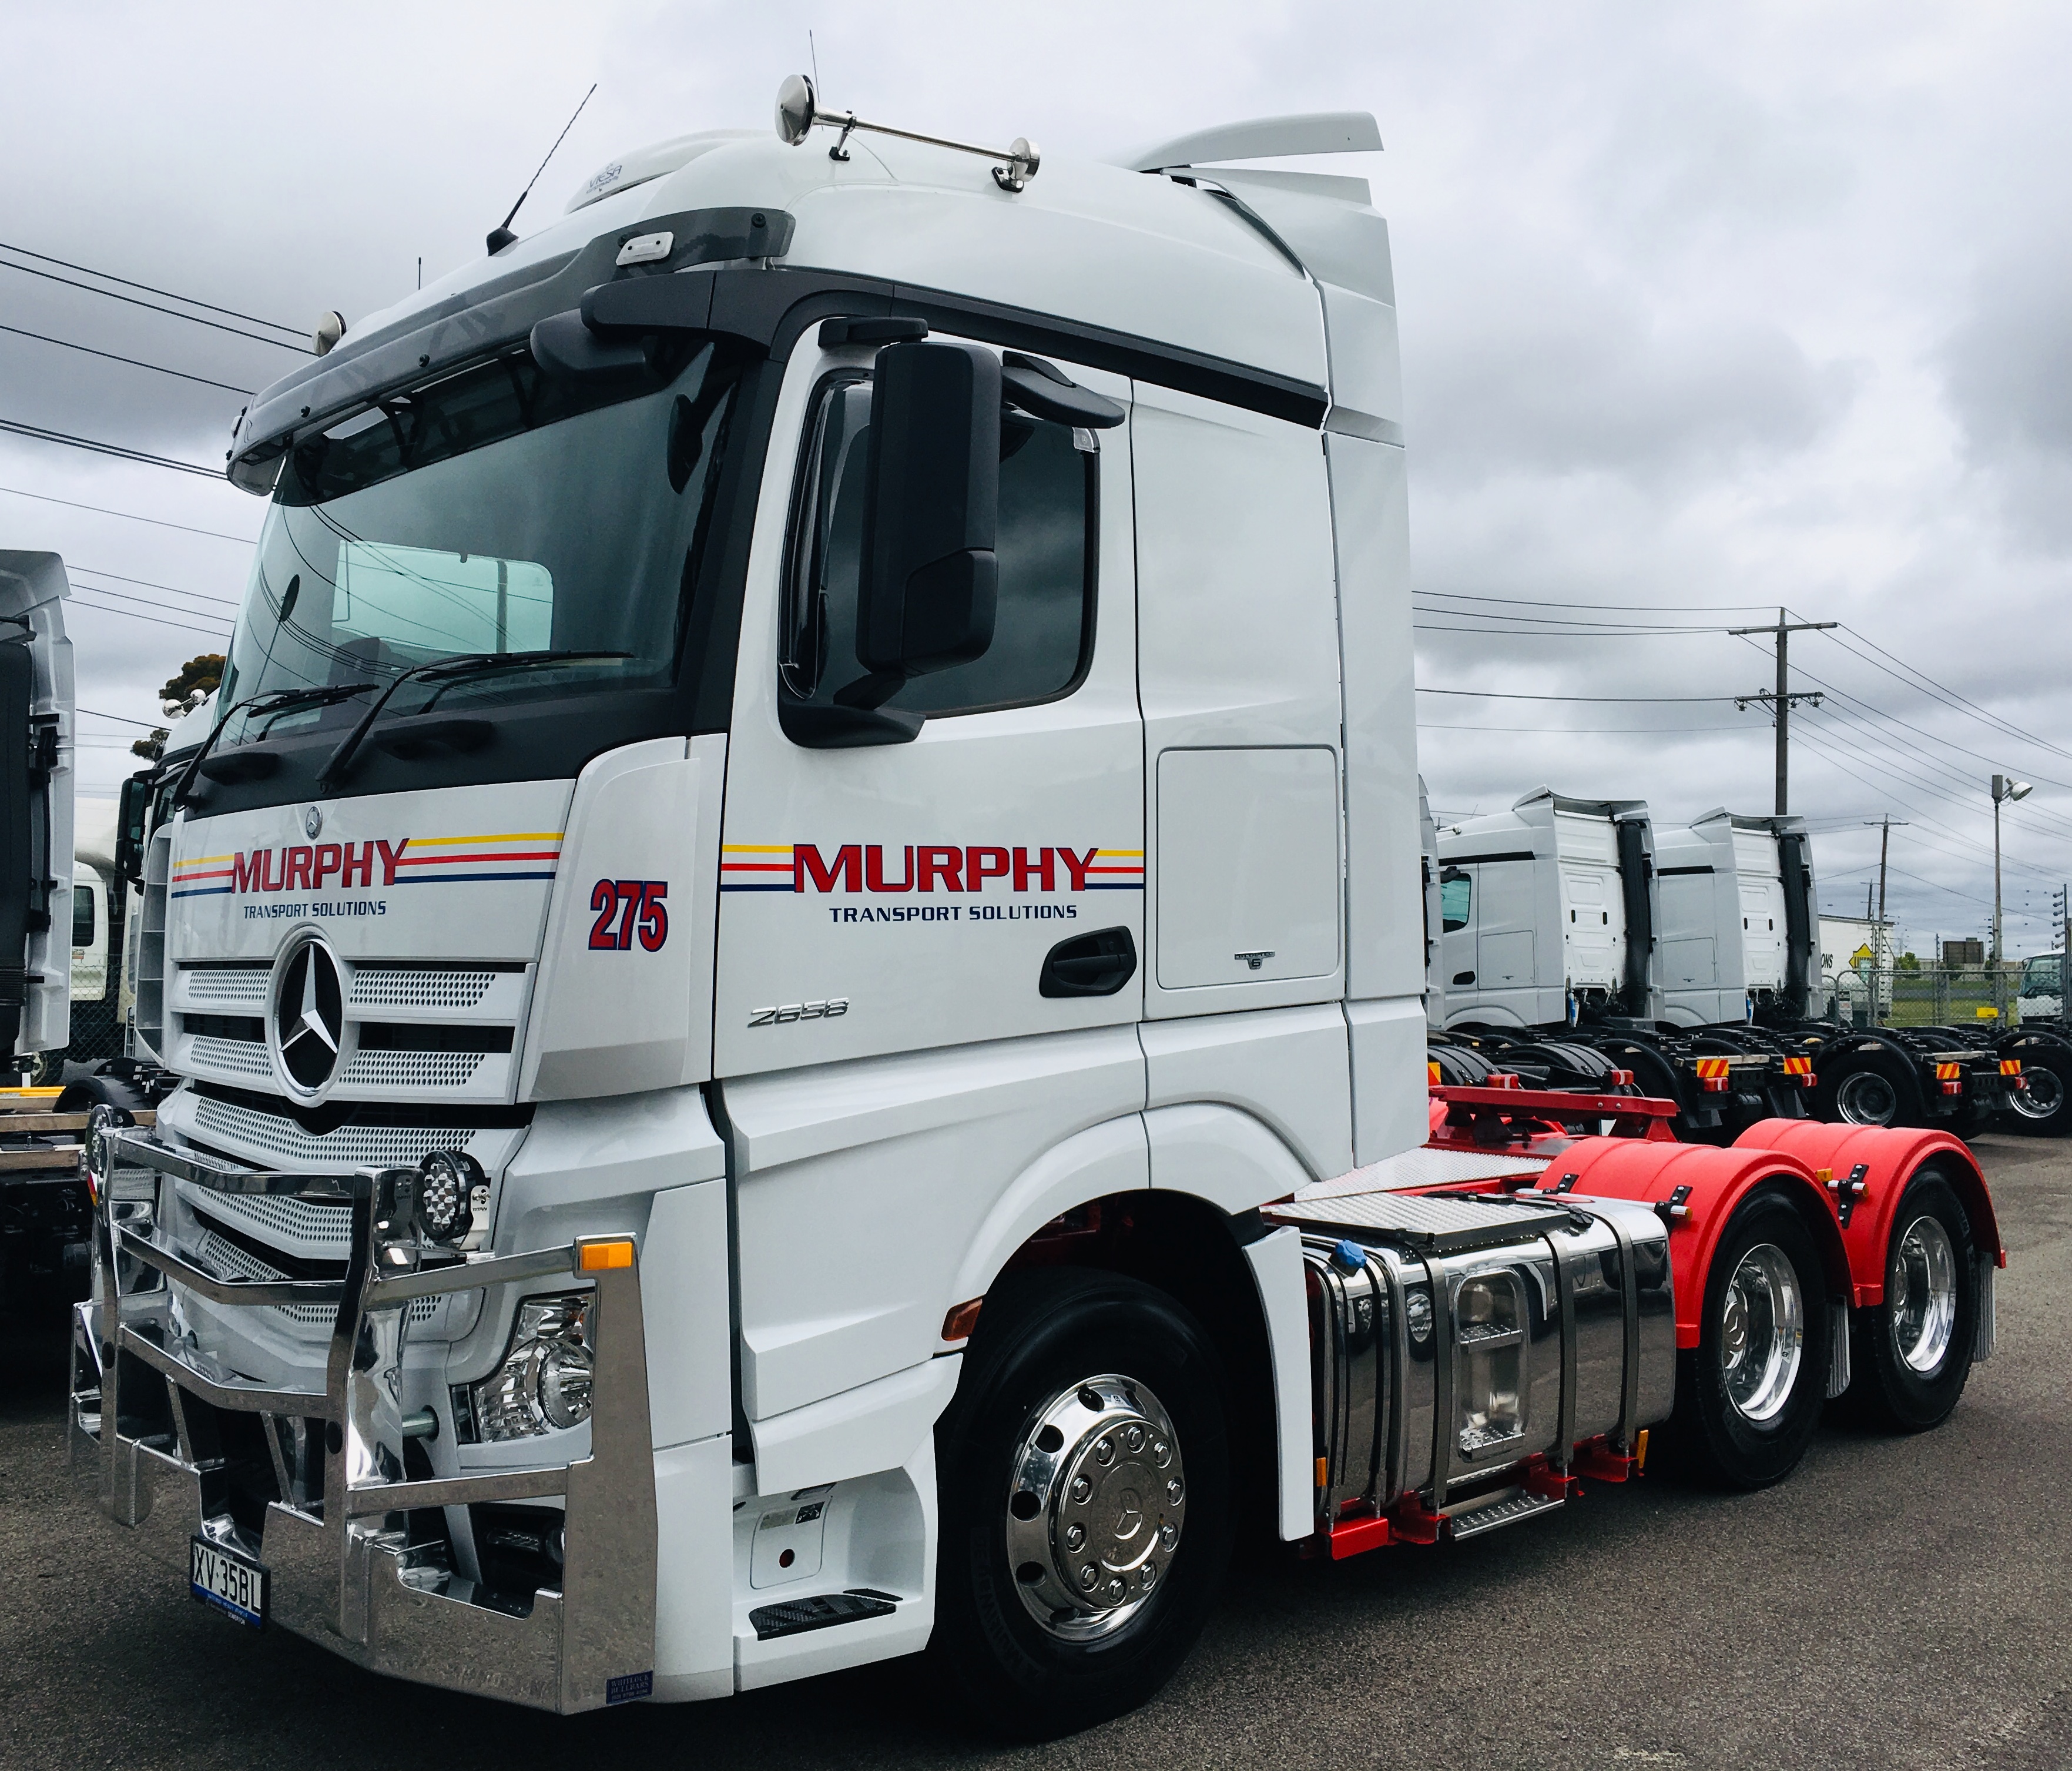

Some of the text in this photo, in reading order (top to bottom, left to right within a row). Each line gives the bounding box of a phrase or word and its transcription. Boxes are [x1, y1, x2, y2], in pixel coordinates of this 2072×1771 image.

[232, 838, 410, 893] MURPHY
[793, 844, 1099, 893] MURPHY
[244, 900, 387, 919] TRANSPORT SOLUTIONS
[588, 879, 668, 952] 275
[829, 905, 1077, 923] TRANSPORT SOLUTIONS
[1252, 959, 1260, 967] 6
[747, 997, 850, 1028] 2658
